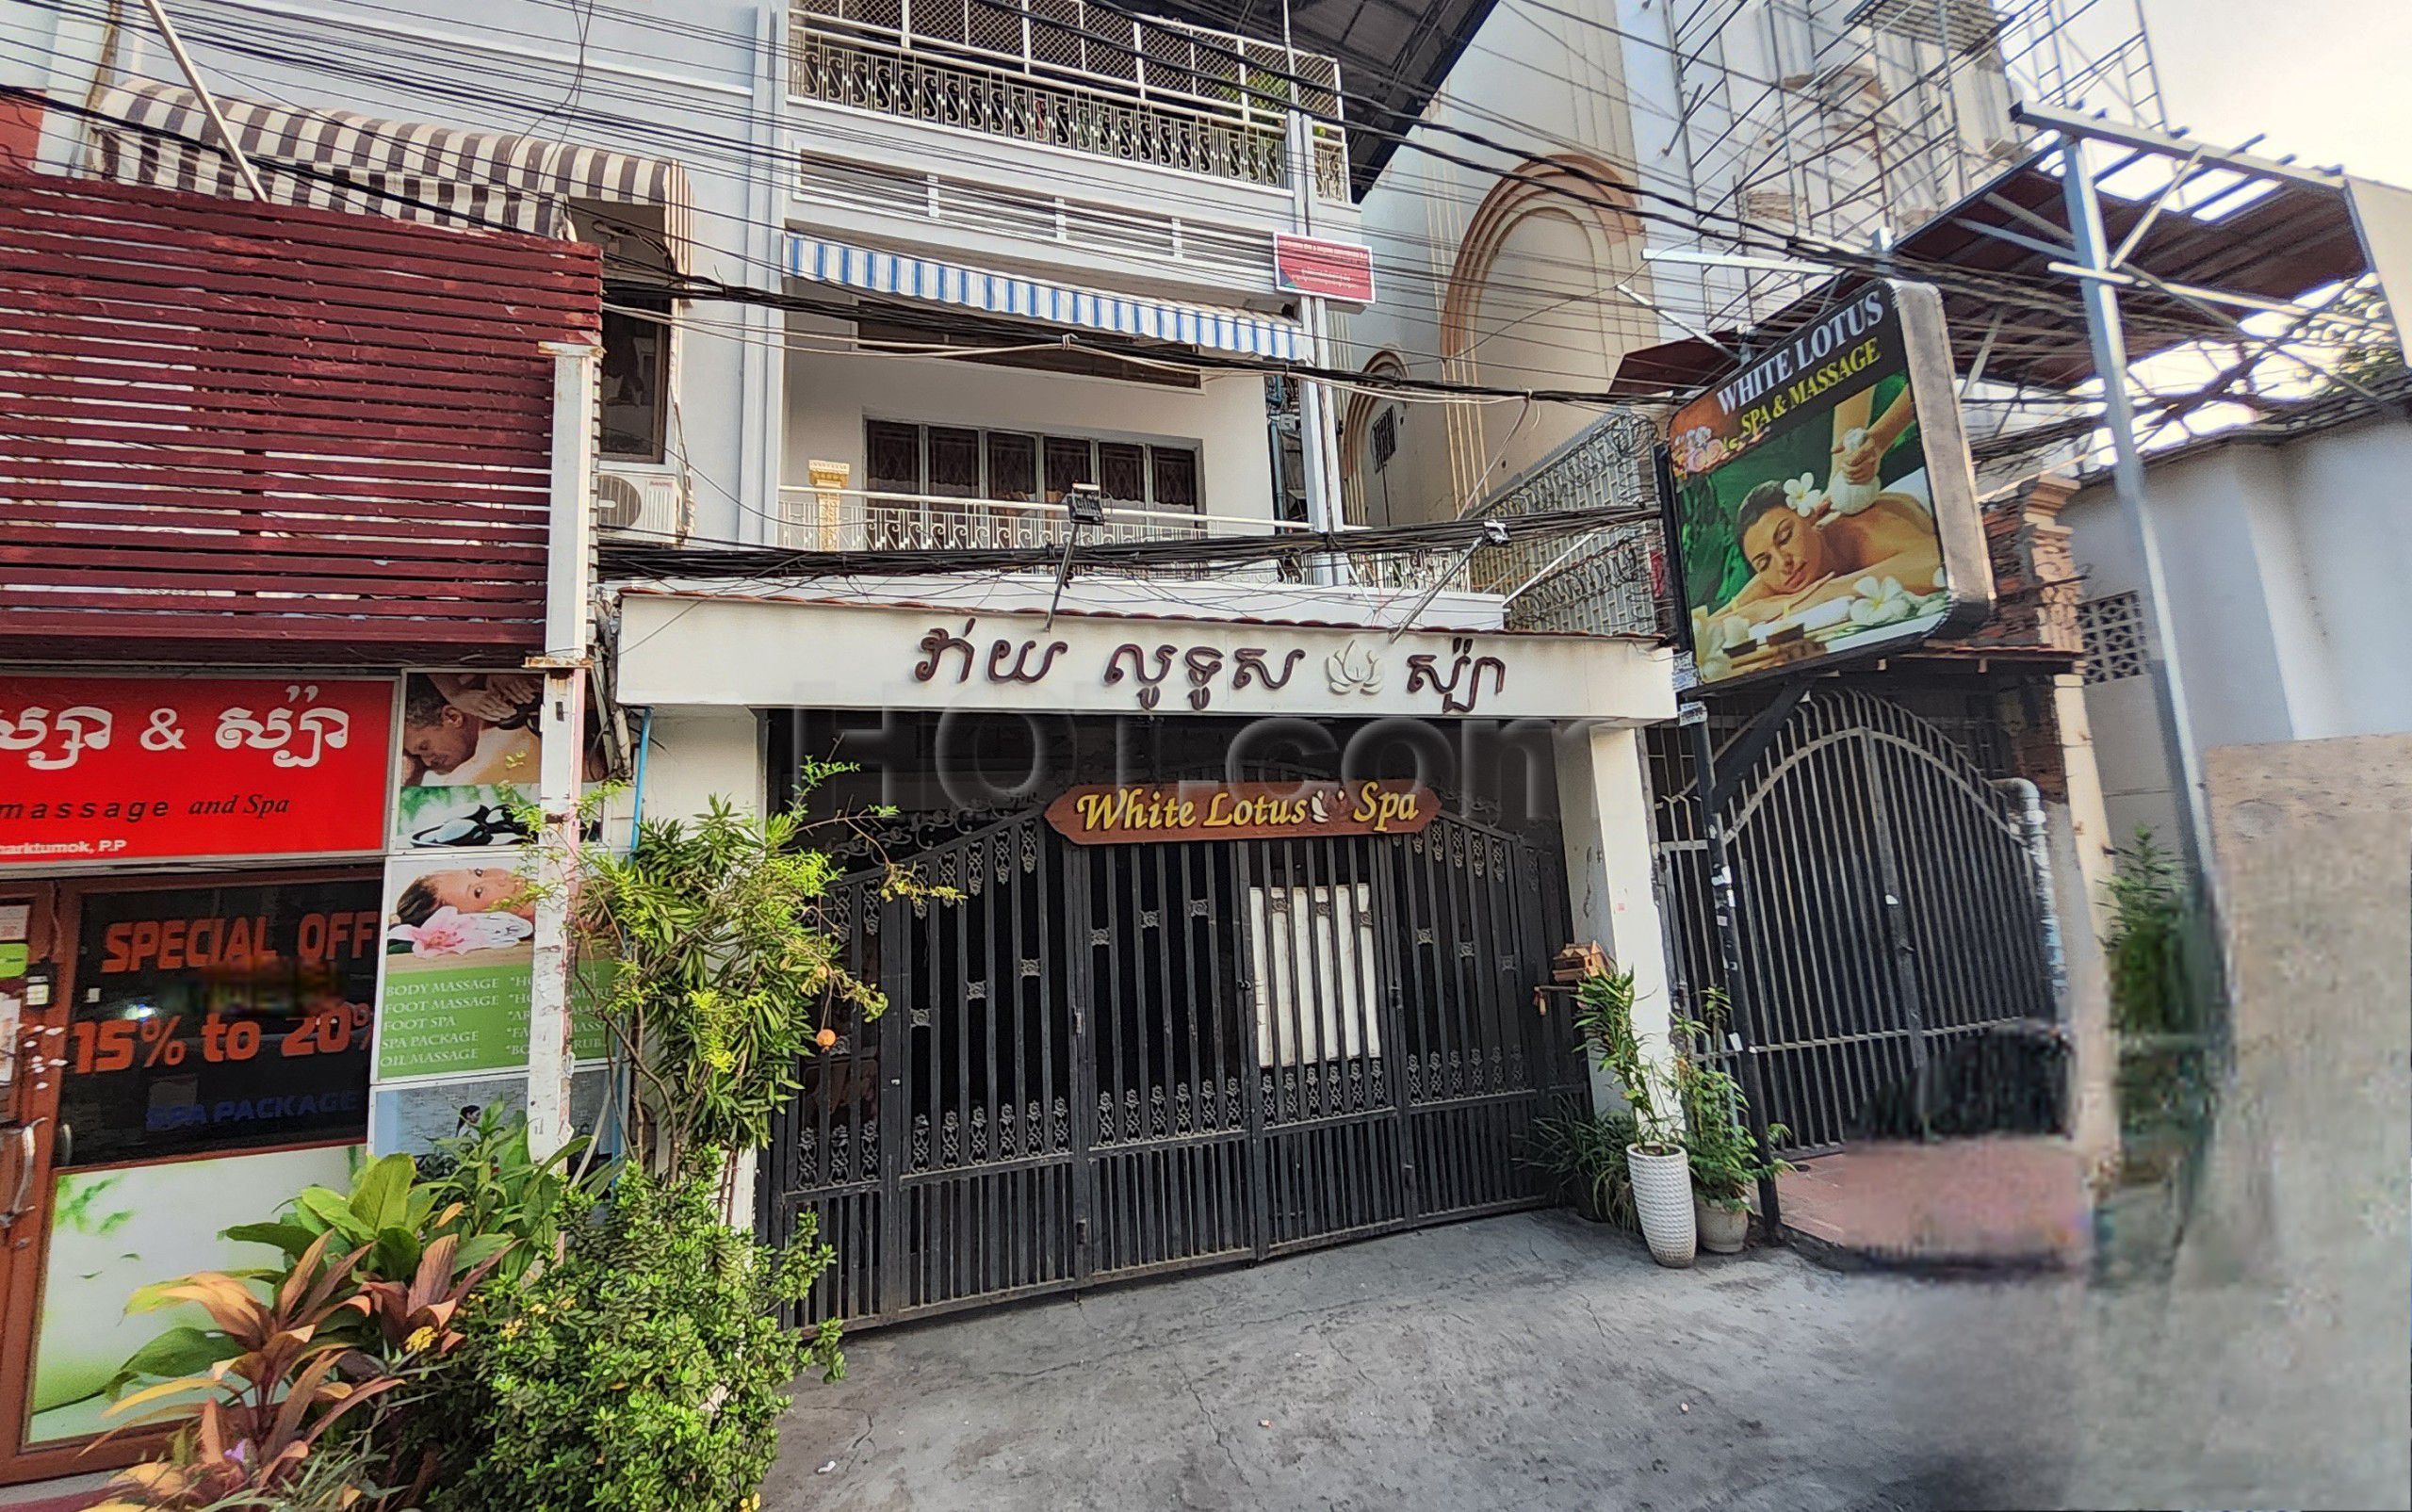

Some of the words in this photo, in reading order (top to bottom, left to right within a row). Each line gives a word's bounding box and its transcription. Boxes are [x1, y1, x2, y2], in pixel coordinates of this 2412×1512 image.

[1717, 350, 1793, 415] WHITE
[1795, 290, 1883, 371] LOTUS
[1741, 405, 1771, 436] SPA
[1772, 394, 1787, 419] &
[1788, 336, 1882, 410] MASSAGE
[140, 707, 187, 751] &
[0, 801, 170, 823] massage
[187, 795, 237, 817] and
[242, 792, 291, 820] Spa
[1076, 788, 1197, 832] White
[1203, 791, 1308, 827] Lotus
[1353, 780, 1420, 833] Spa
[100, 916, 277, 973] SPECIAL
[383, 1000, 428, 1015] FOOT
[431, 995, 499, 1011] MASSAGE
[384, 984, 429, 998] BODY
[432, 978, 499, 993] MASSAGE
[381, 1037, 407, 1050] SPA
[410, 1030, 480, 1048] PACKAGE
[383, 1017, 428, 1032] FOOT
[430, 1016, 456, 1029] SPA
[72, 1015, 187, 1074] 15%
[200, 1012, 261, 1063] to
[380, 1054, 406, 1067] OIL
[410, 1048, 480, 1065] MASSAGE
[213, 1090, 361, 1124] PACKAGE
